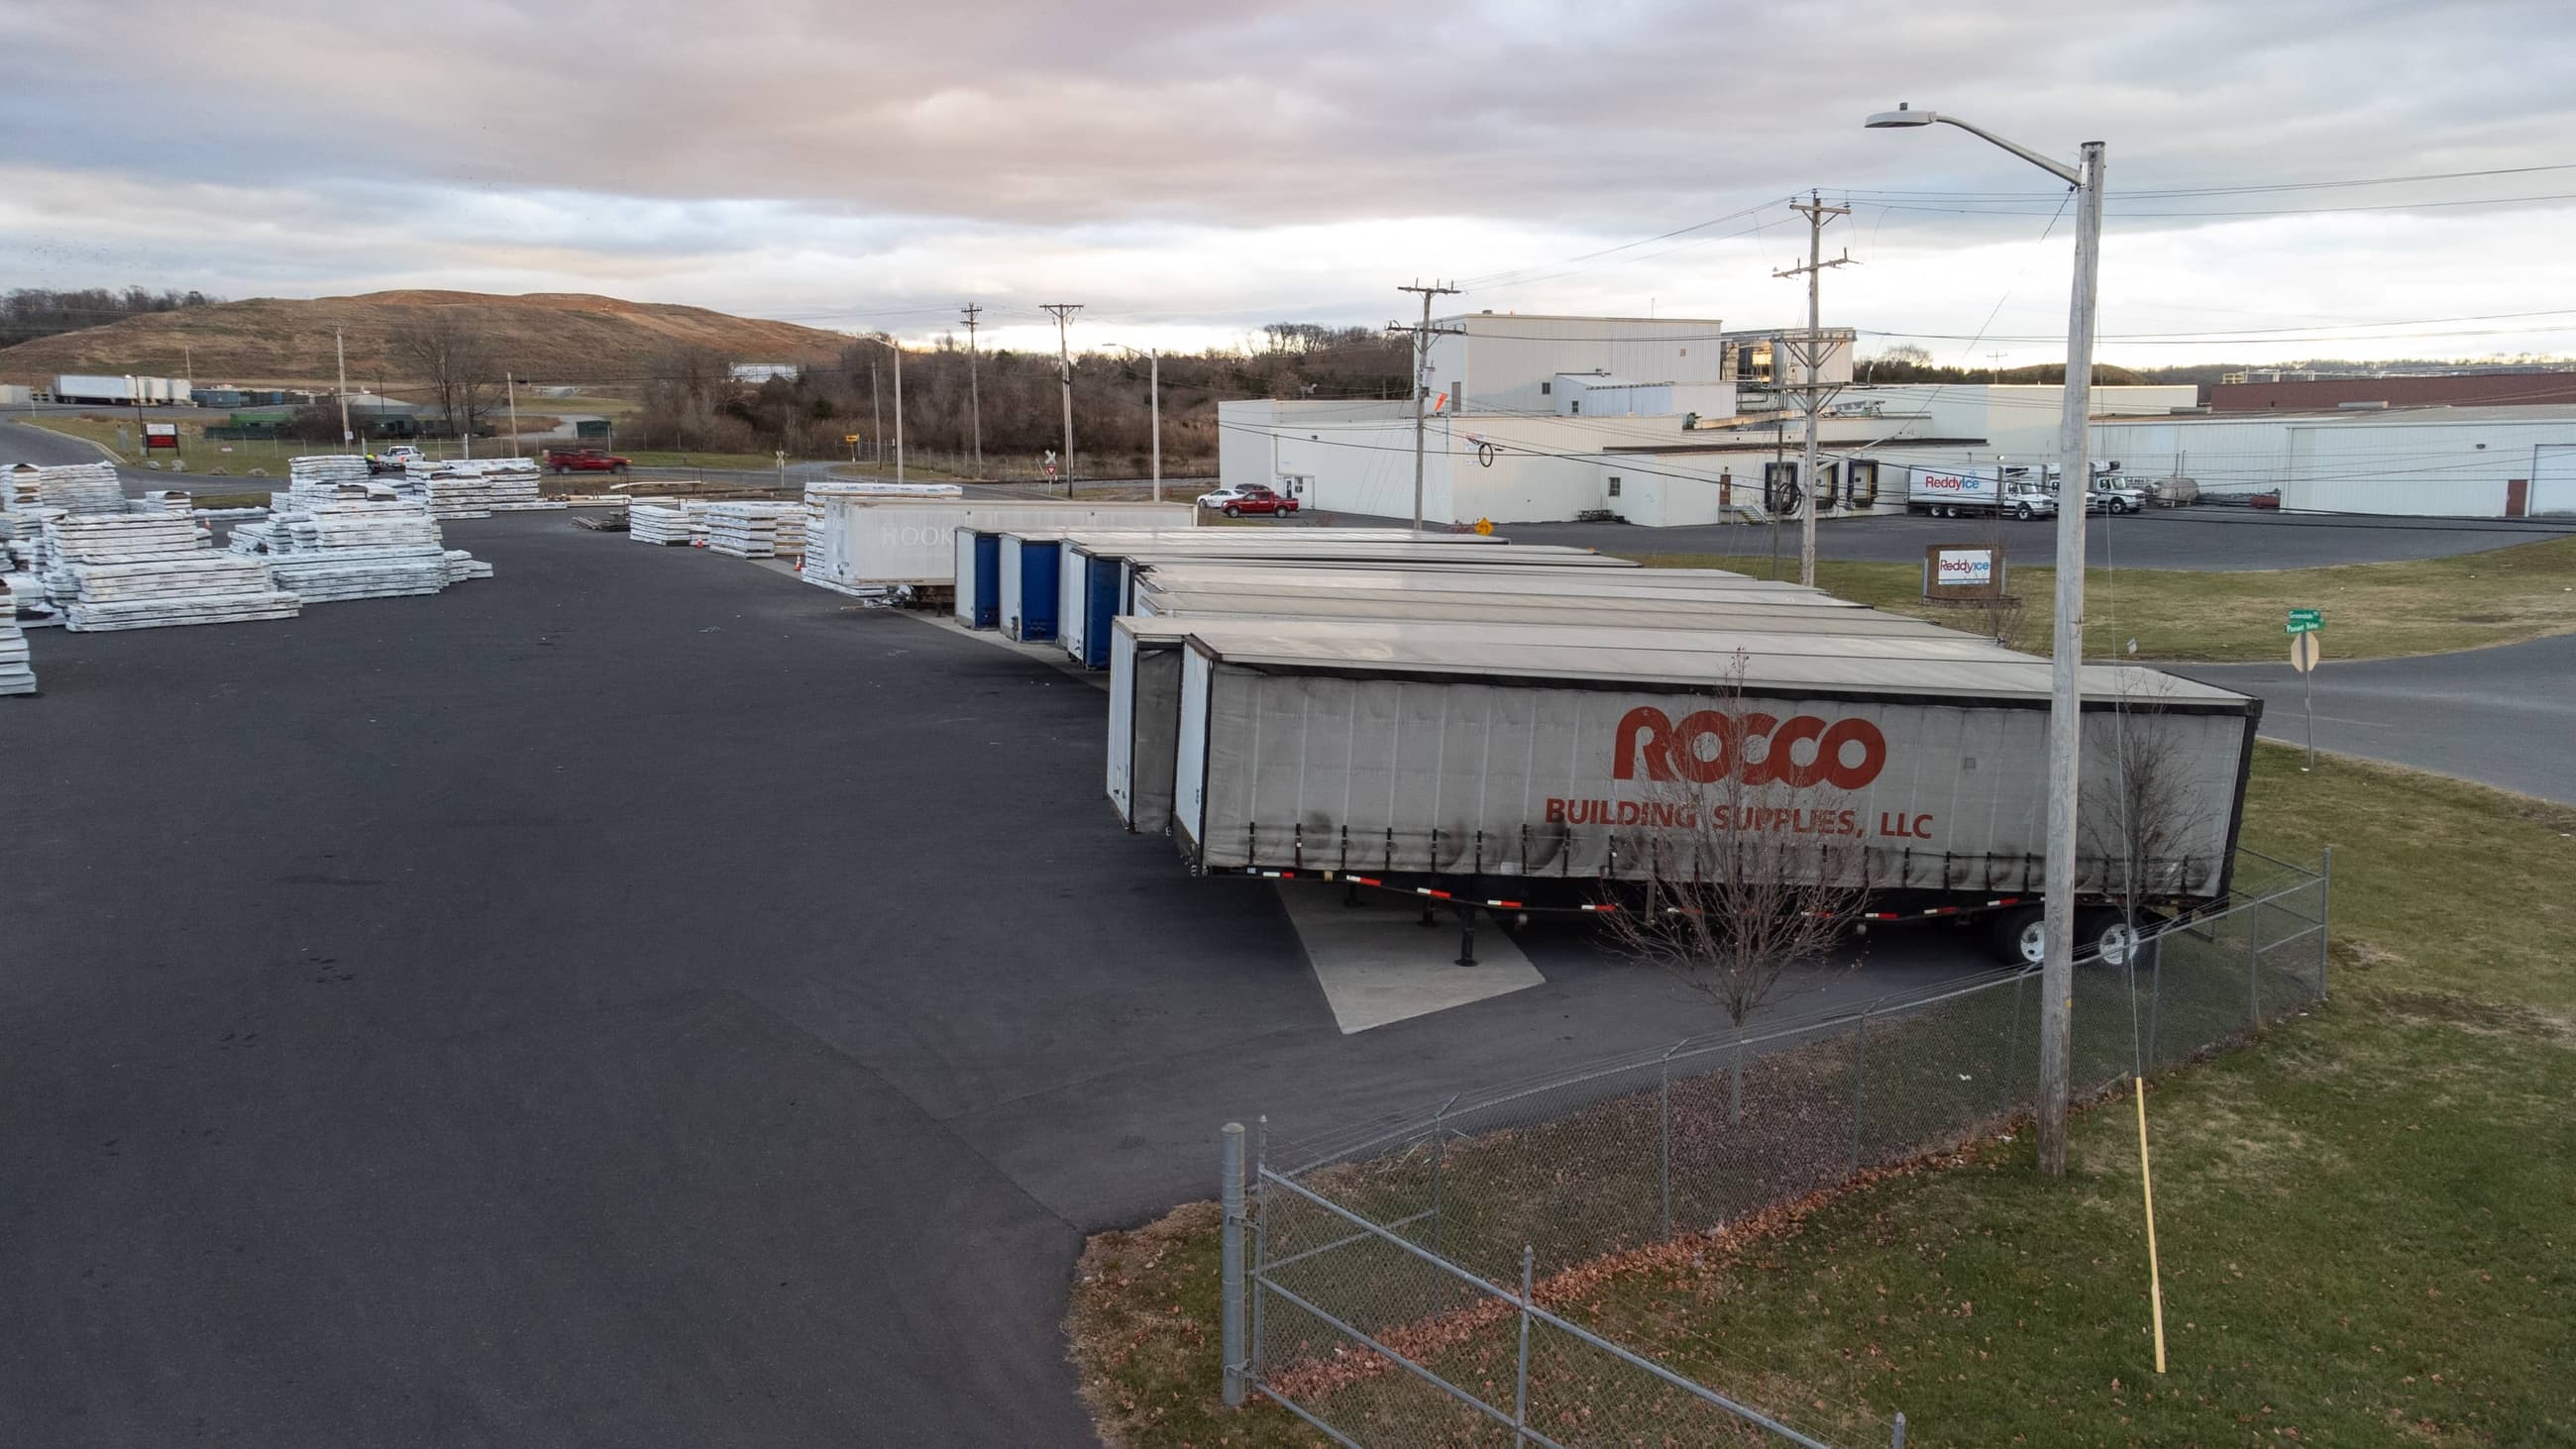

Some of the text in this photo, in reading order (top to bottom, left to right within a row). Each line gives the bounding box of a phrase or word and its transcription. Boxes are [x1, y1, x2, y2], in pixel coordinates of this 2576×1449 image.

[1613, 706, 1887, 790] ROCCO
[1545, 797, 1934, 840] BUILDING SUPPLIES, LLC
